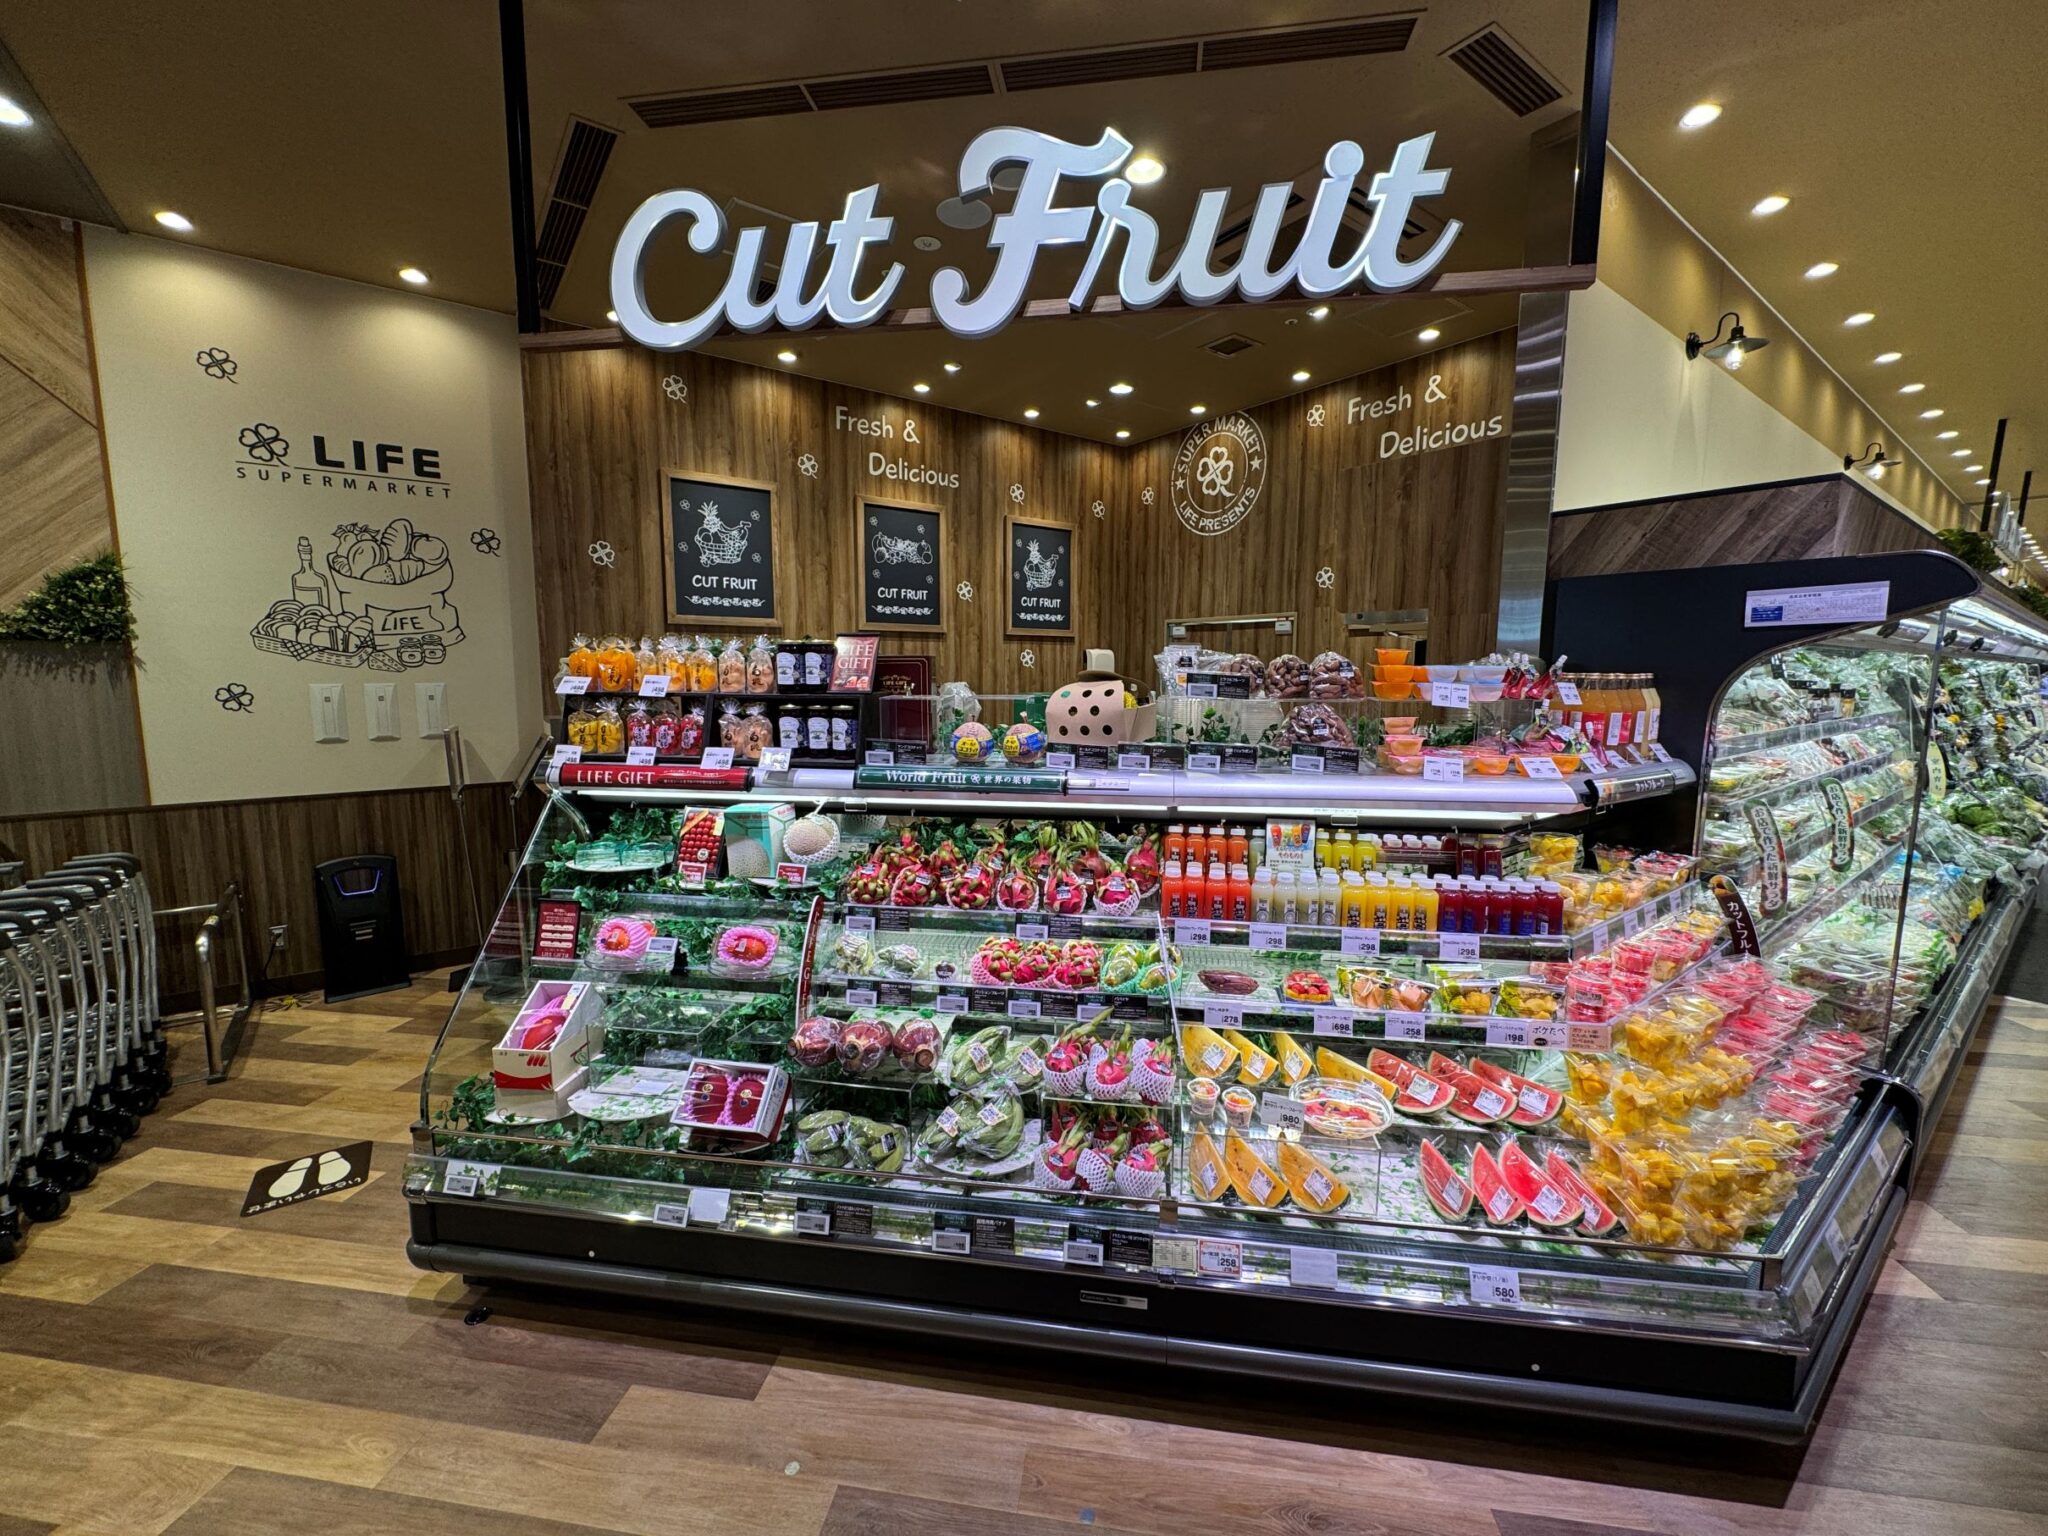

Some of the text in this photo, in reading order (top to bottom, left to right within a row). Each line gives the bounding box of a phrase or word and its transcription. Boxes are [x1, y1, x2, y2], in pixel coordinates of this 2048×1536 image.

[609, 125, 1464, 352] Cut Fruit
[1347, 373, 1447, 425] Fresh &
[834, 405, 921, 444] Fresh &
[1178, 415, 1261, 473] SUPER MARKET
[1379, 414, 1504, 459] Delicious
[313, 435, 441, 479] LIFE
[868, 451, 960, 489] Delicious
[236, 466, 451, 499] SUPERMARKET
[1179, 486, 1256, 531] LIFE PRESENTS
[692, 574, 758, 591] CUT FRUIT
[877, 586, 929, 601] CUT FRUIT
[1020, 596, 1061, 609] CUT FRUIT
[381, 616, 423, 631] LIFE
[838, 657, 871, 669] GIFT
[577, 770, 613, 784] LIFE
[617, 770, 656, 785] GIFT
[885, 770, 967, 784] World Fruit
[984, 775, 1032, 785] 世界の果物
[1829, 785, 1848, 864] お店で作った新鮮サラダ
[1753, 807, 1781, 909] お店で作った新鮮サラダ
[1460, 948, 1476, 956] 298
[1334, 1023, 1350, 1031] 698
[1406, 1028, 1422, 1036] 258
[1532, 1025, 1566, 1036] ポケたべ
[1508, 1034, 1524, 1042] 198
[1282, 1114, 1300, 1124] 980
[246, 1177, 362, 1214] いらっしゃいませ
[1220, 1258, 1236, 1267] 258
[1495, 1287, 1514, 1298] 580
